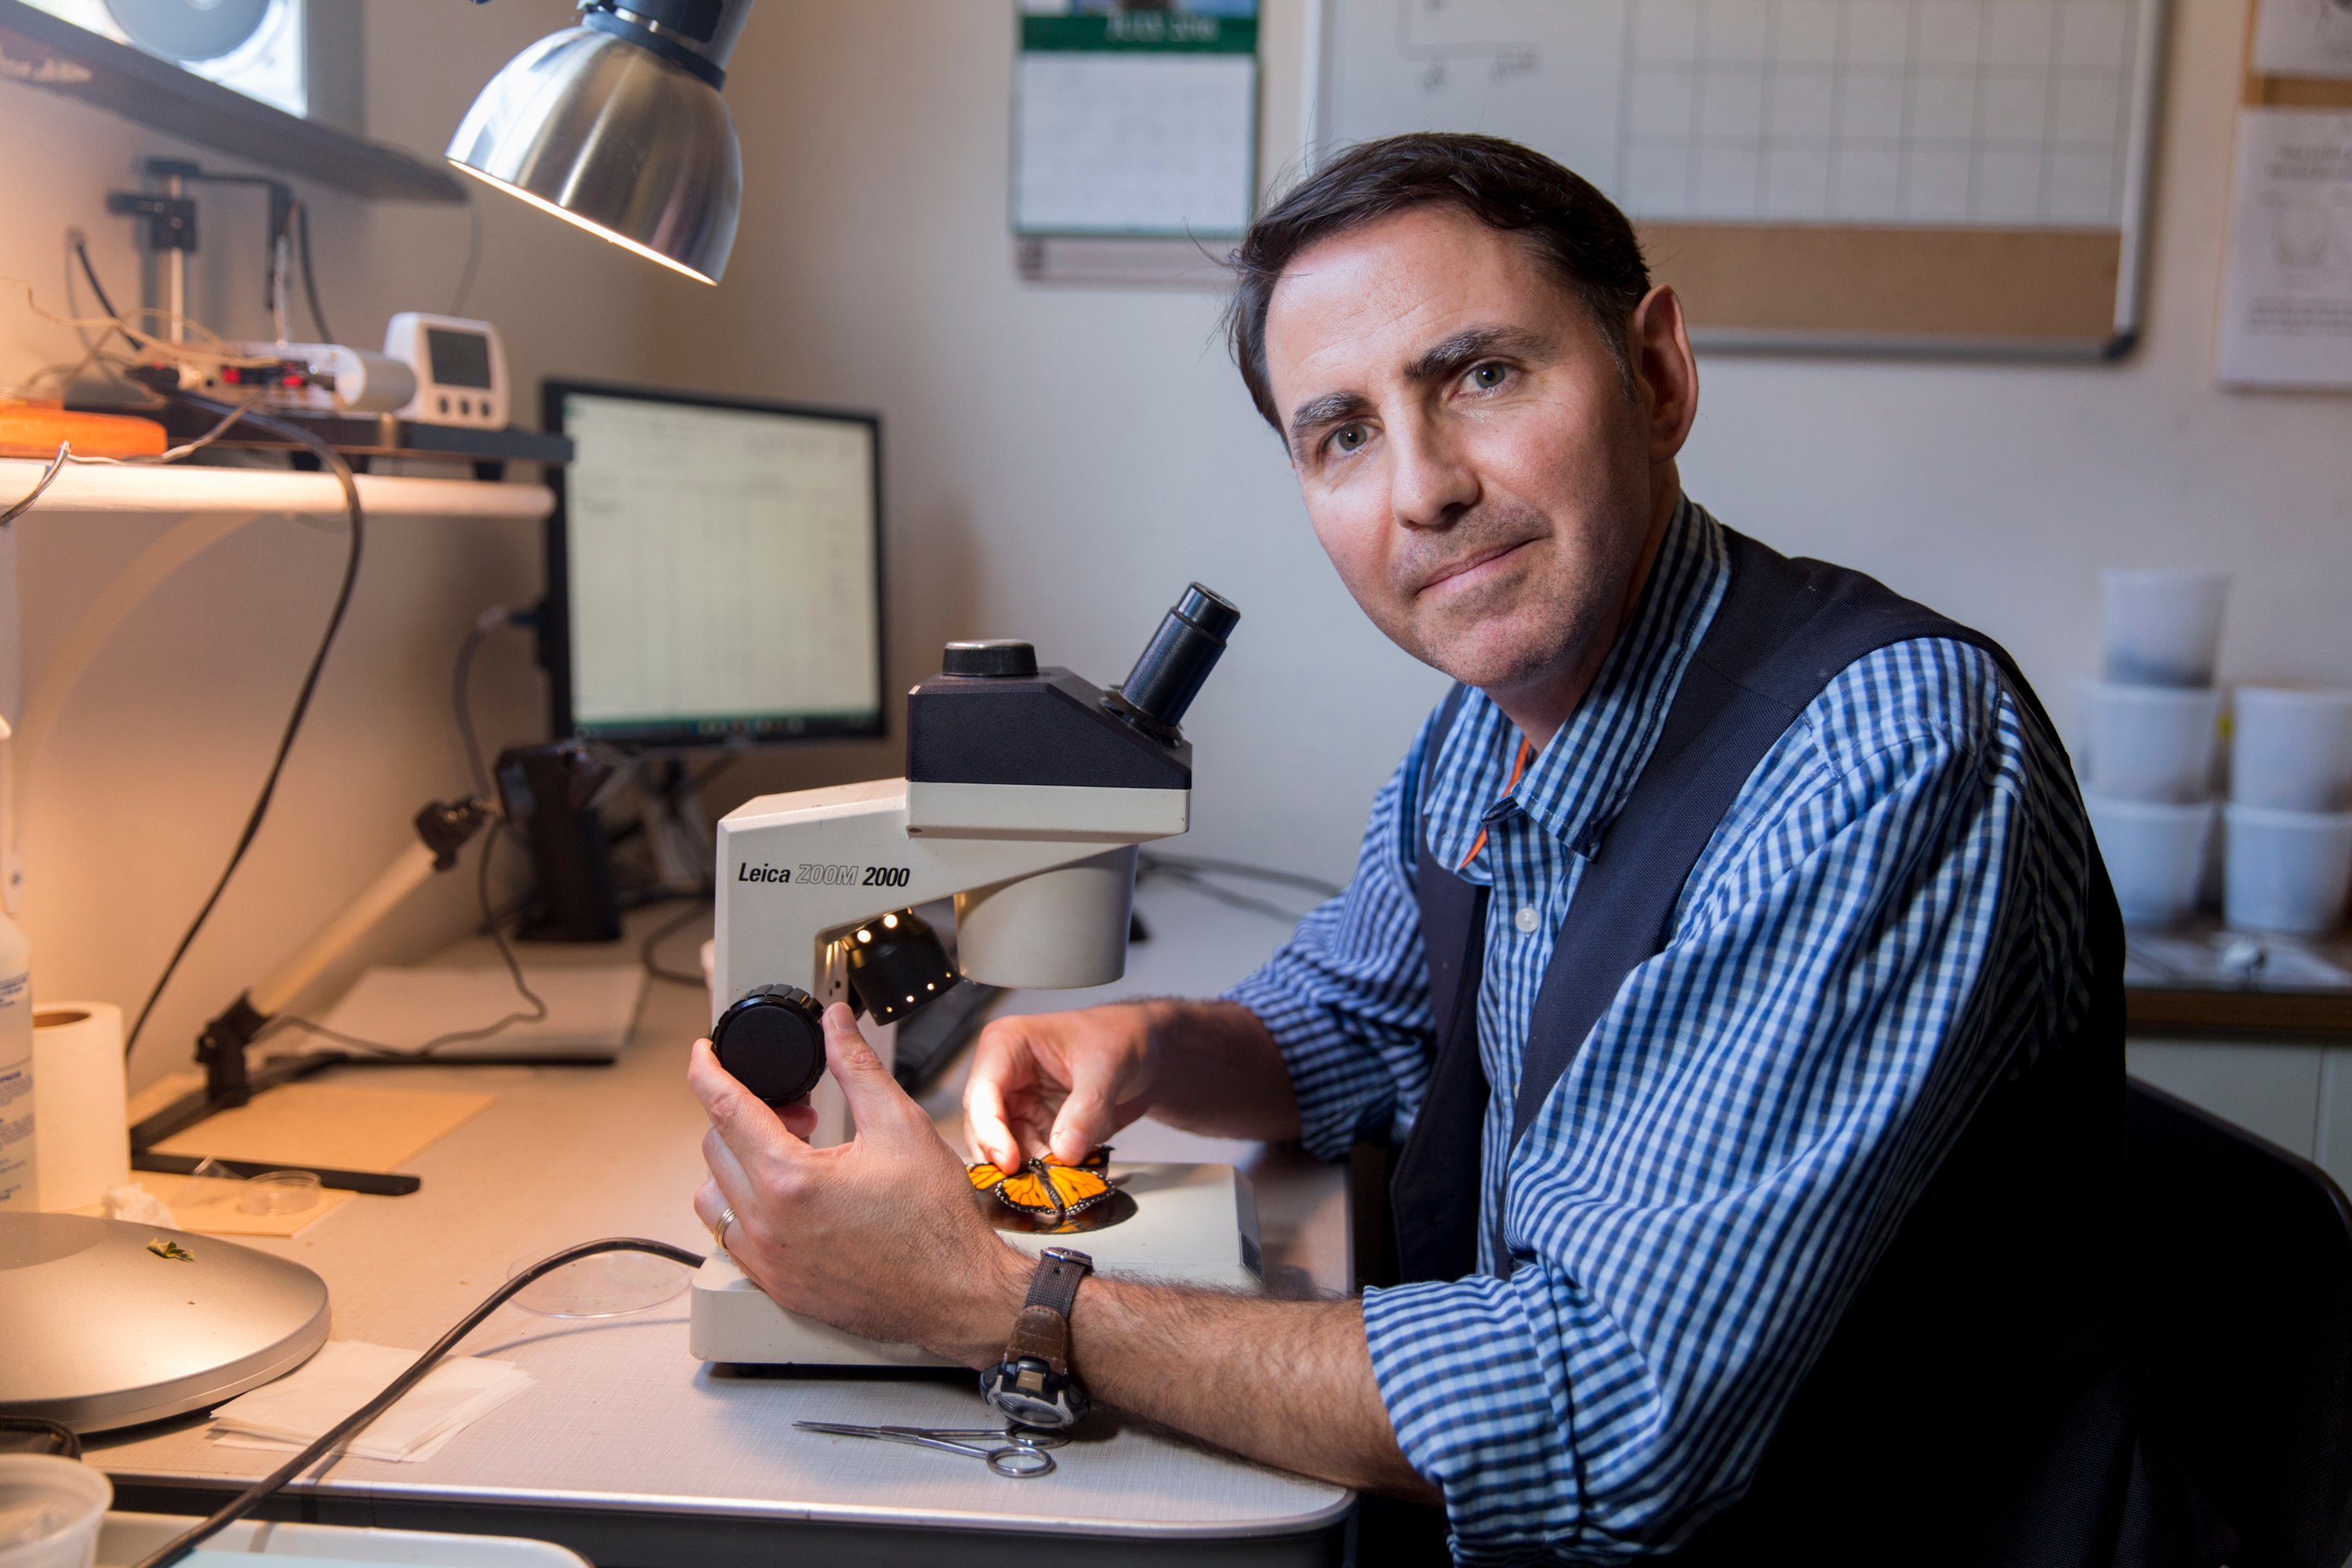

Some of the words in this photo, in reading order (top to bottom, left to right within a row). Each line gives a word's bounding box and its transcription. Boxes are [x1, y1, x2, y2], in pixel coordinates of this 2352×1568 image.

[739, 862, 791, 883] Leica
[796, 864, 858, 885] ZOOM
[862, 866, 910, 887] 2000
